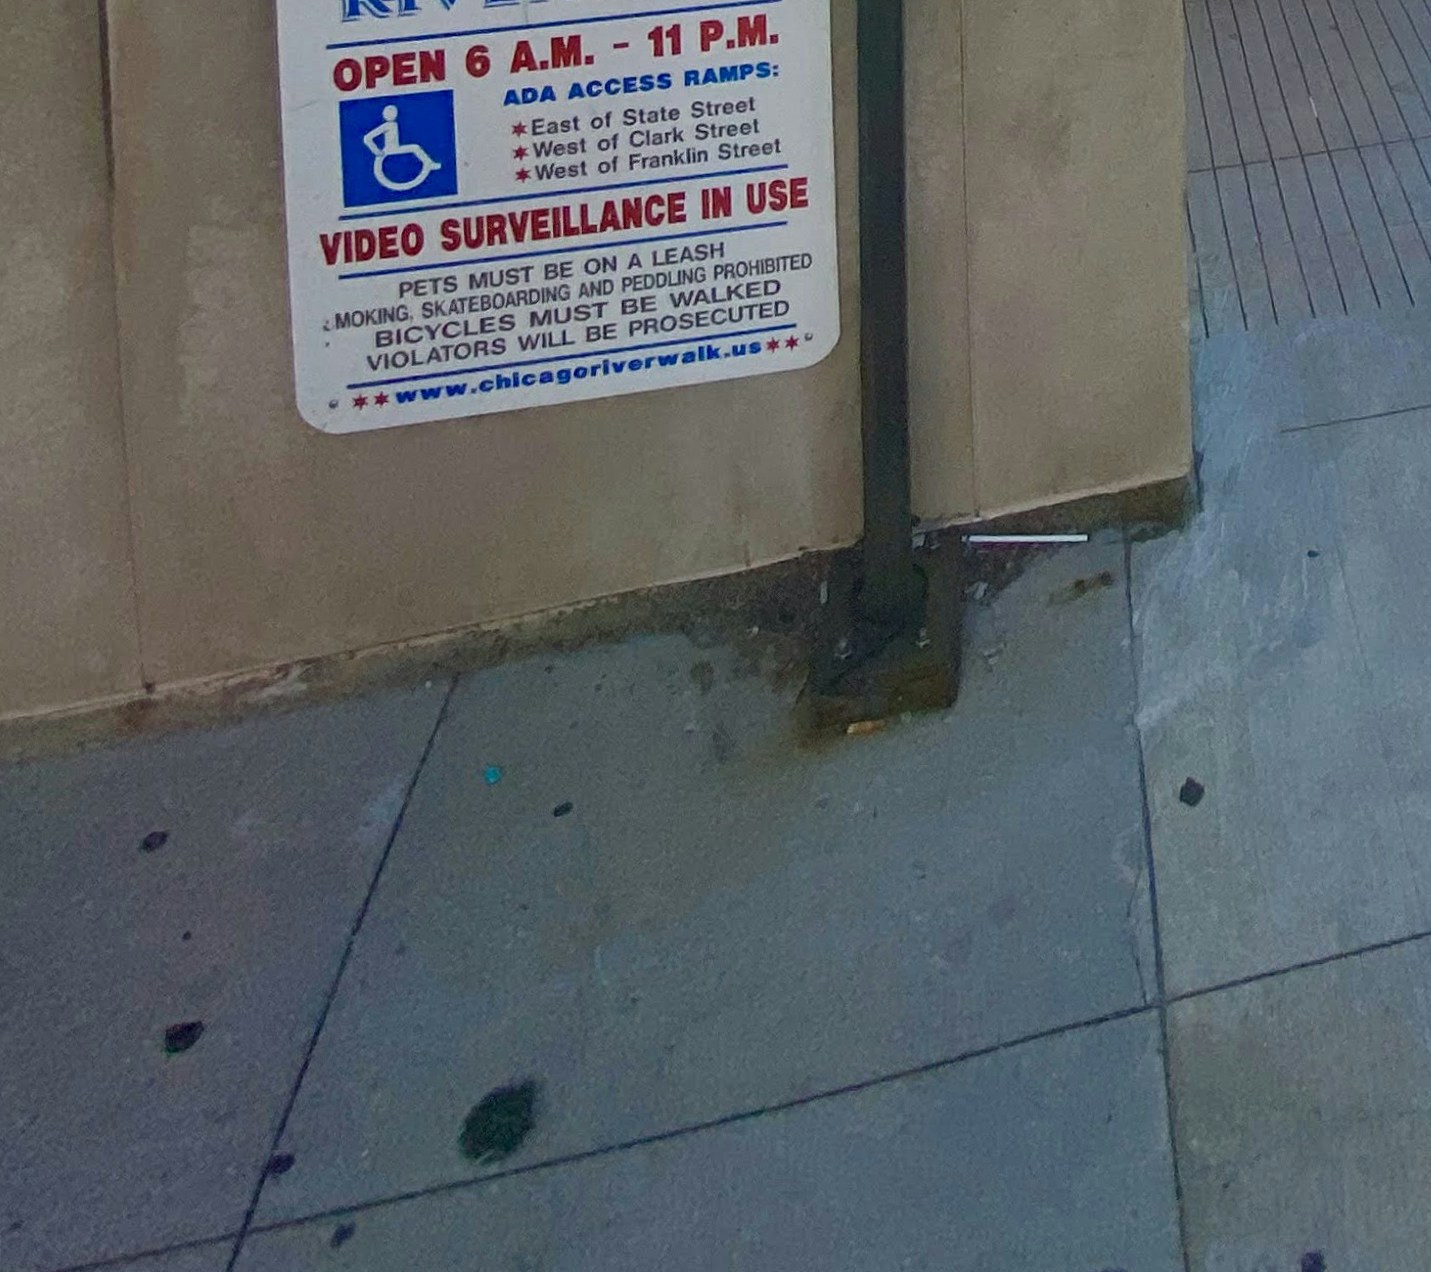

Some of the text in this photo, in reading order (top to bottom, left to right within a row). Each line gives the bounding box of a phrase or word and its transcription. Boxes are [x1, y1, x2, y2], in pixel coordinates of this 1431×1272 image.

[333, 13, 780, 92] OPEN 6 A.M. - 11 P.M.
[503, 61, 780, 107] ADA ACCESS RAMPS:
[531, 96, 757, 137] East of State Street
[532, 118, 760, 159] West of Clark Street
[534, 138, 782, 182] West of Franklin Street
[319, 176, 810, 266] VIDEO SURVEILLANCE IN USE
[399, 241, 725, 299] PETS MUST BE ON A LEASH
[421, 284, 571, 320] SKATEBOARDING
[578, 278, 615, 299] AND
[621, 266, 707, 294] PEDDLING
[713, 252, 813, 281] PROHIBITED
[366, 299, 790, 372] VIOLATORS WILL BE PROSECUTED
[375, 279, 782, 349] BICYCLES MUST BE WALKED
[395, 340, 763, 405] www.chicagoriverwalk.us
